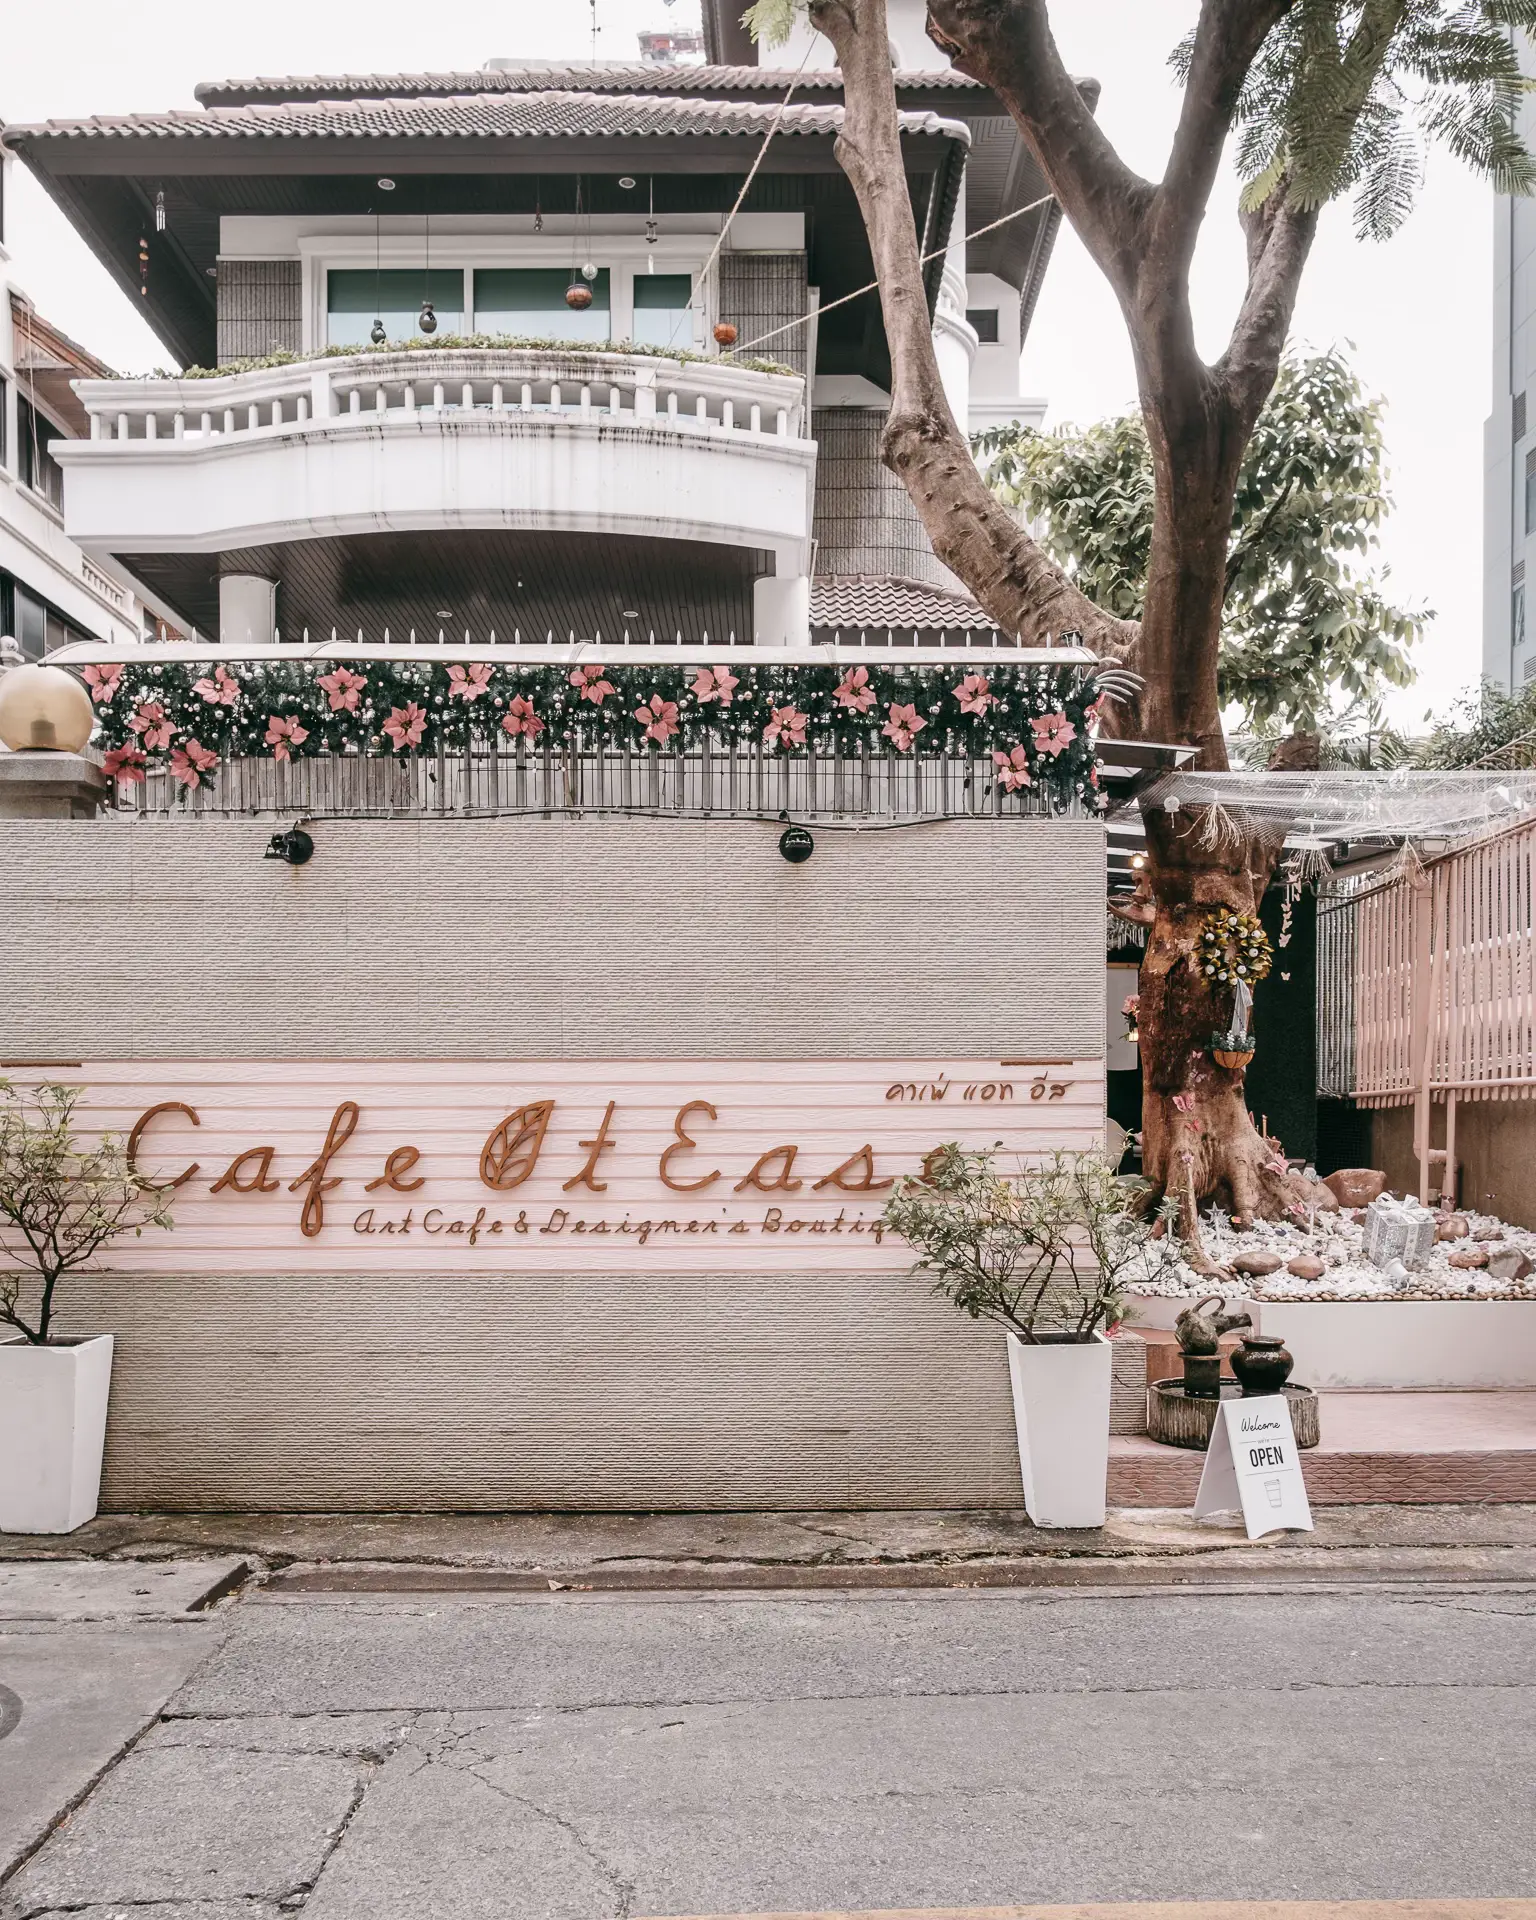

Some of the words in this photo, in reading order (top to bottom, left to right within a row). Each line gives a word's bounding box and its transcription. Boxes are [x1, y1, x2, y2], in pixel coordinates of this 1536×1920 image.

[126, 1101, 426, 1237] Cafe
[353, 1208, 413, 1234] Art
[423, 1207, 503, 1245] Cafe
[514, 1210, 529, 1234] &
[539, 1208, 749, 1244] Designer's
[761, 1207, 905, 1244] Boutiq
[1241, 1415, 1281, 1432] Welcome
[1249, 1446, 1284, 1468] OPEN
